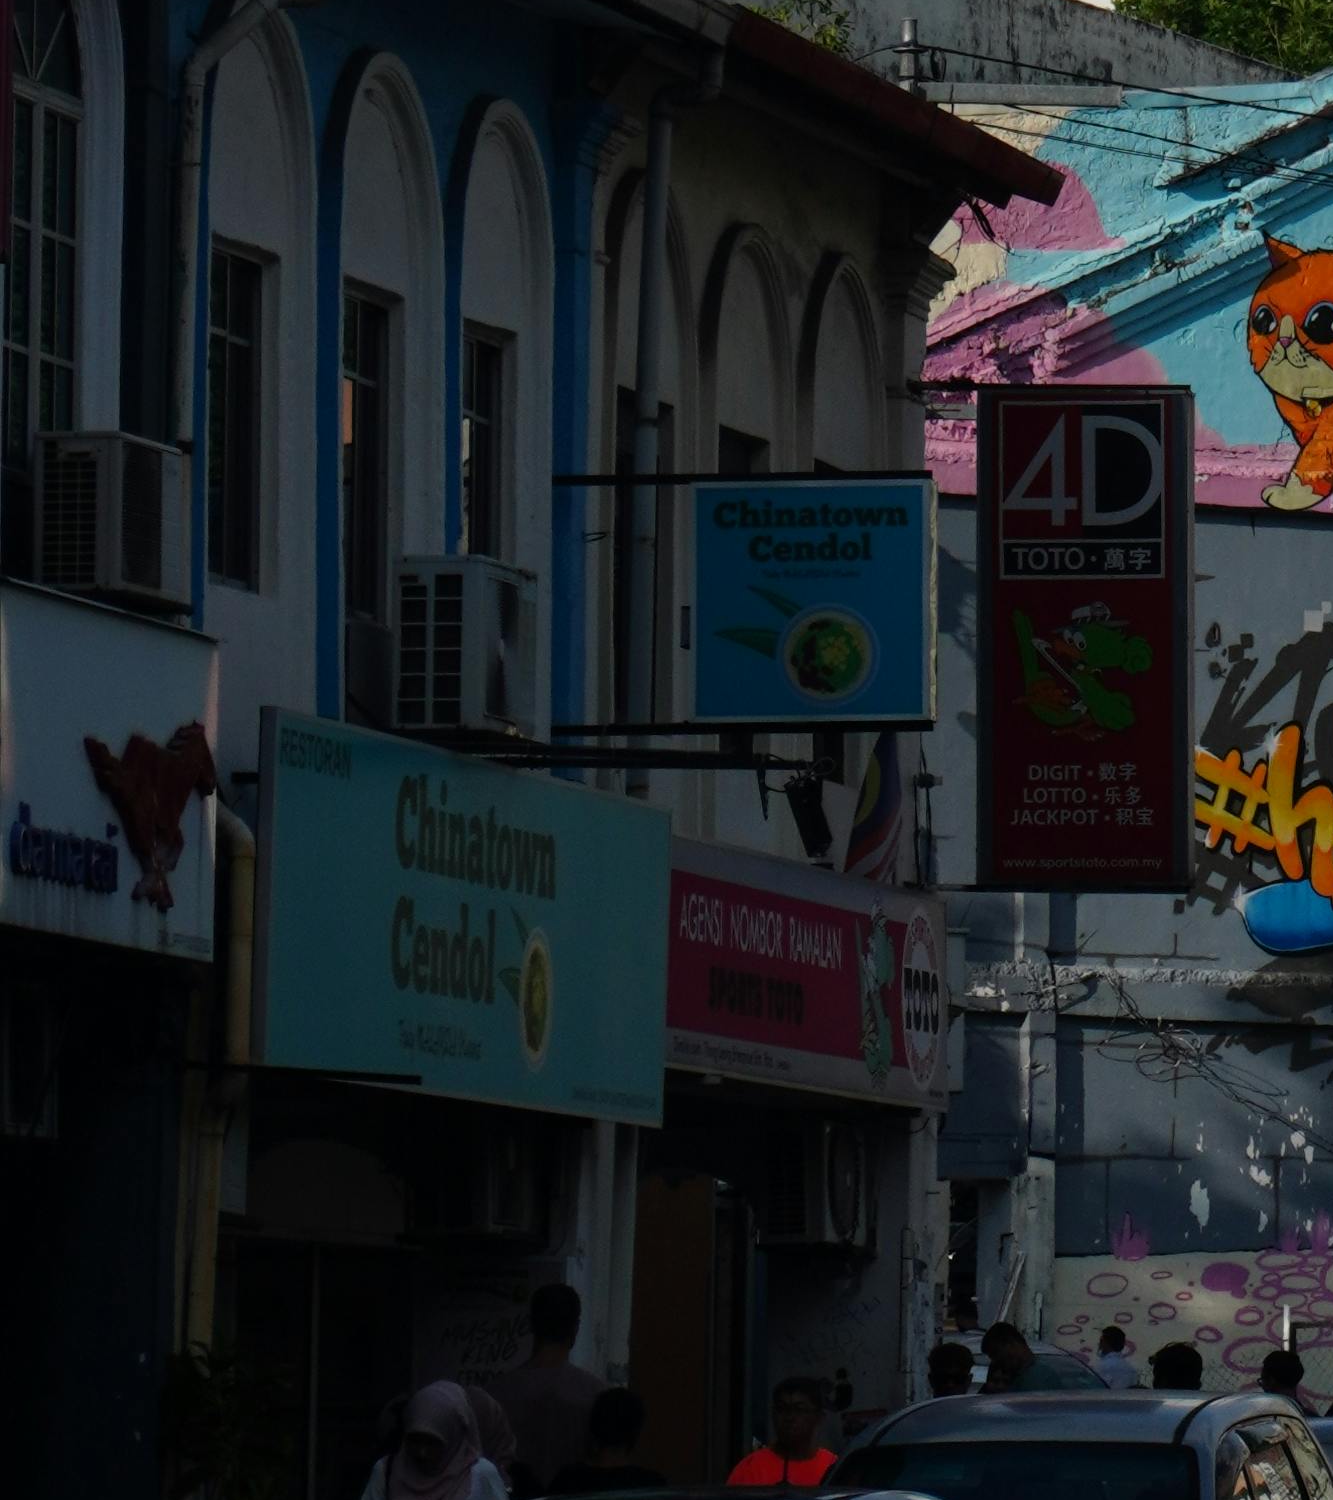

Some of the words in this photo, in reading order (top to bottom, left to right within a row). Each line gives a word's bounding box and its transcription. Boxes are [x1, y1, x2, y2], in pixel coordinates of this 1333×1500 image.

[1001, 413, 1163, 527] 4D
[713, 499, 909, 529] Chinatown
[748, 532, 872, 562] Cendol
[1011, 547, 1087, 571] TOTO
[1103, 547, 1152, 572] 萬字
[280, 729, 353, 778] RESTORAN
[1028, 764, 1082, 782] DIGIT
[1098, 763, 1136, 781] 数字
[1023, 786, 1086, 804] LOTTO
[1103, 786, 1142, 804] 乐多
[395, 773, 556, 900] Chinatown
[1010, 809, 1098, 826] JACKPOT
[1115, 808, 1154, 825] 积宝
[1002, 857, 1163, 870] www.sportstoto.com.my
[391, 895, 496, 1005] Cendol
[680, 893, 724, 948] AGENSI
[730, 904, 784, 960] NOMBOR
[789, 916, 843, 969] RAMALAN
[708, 966, 763, 1019] SPORTS
[767, 976, 804, 1026] TOTO
[903, 968, 940, 1036] TOTO
